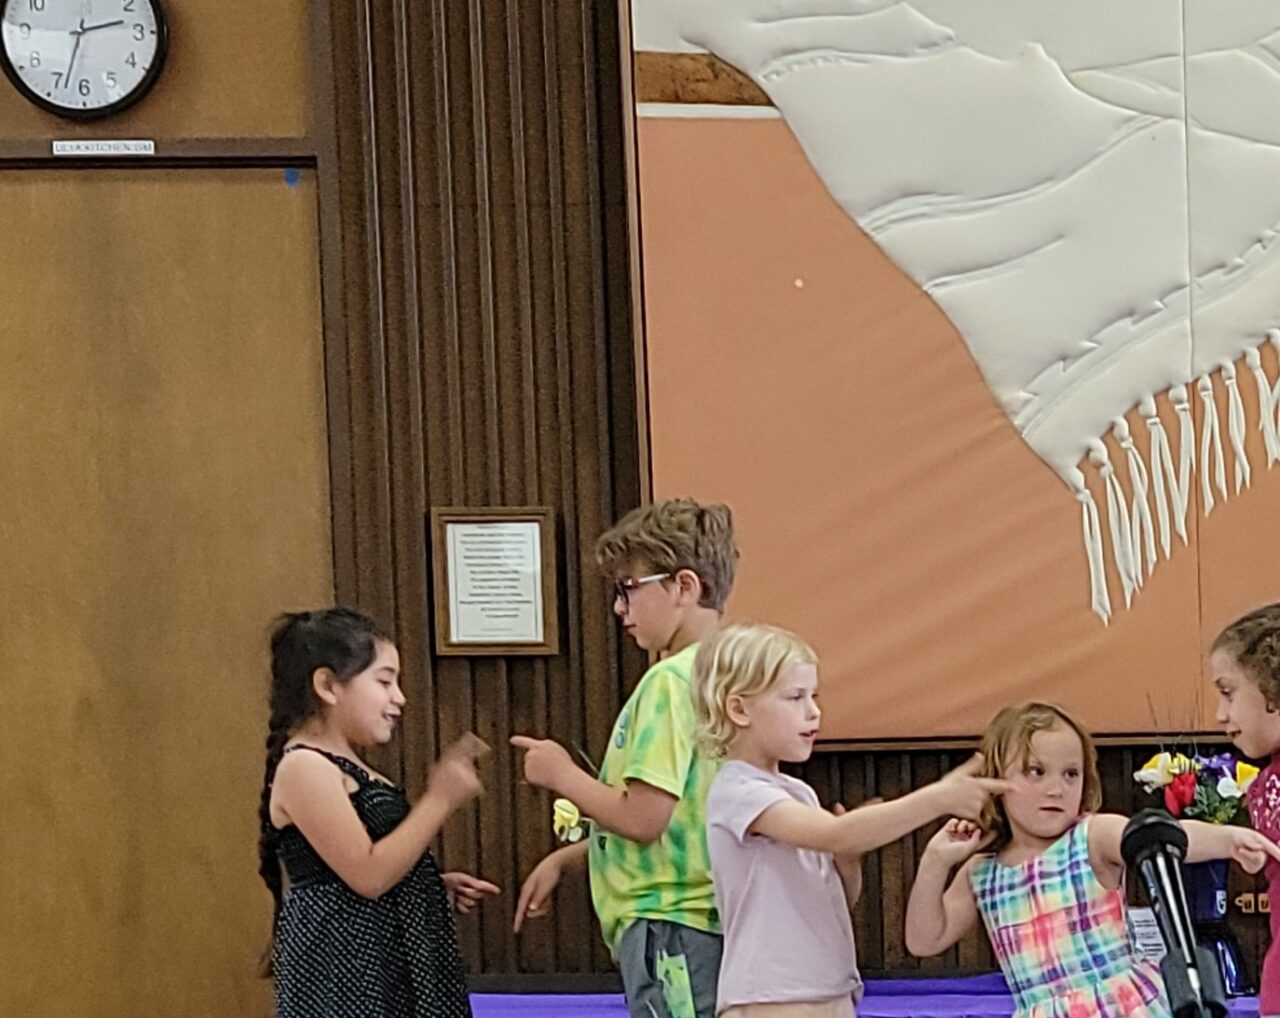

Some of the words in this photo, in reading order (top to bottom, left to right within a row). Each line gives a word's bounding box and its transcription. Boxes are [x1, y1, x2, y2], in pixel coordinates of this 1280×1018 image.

[123, 0, 135, 12] 2
[19, 23, 31, 40] 9
[133, 23, 145, 41] 3
[125, 52, 137, 68] 4
[51, 72, 63, 89] 7
[78, 79, 90, 96] 6
[105, 72, 117, 87] 5
